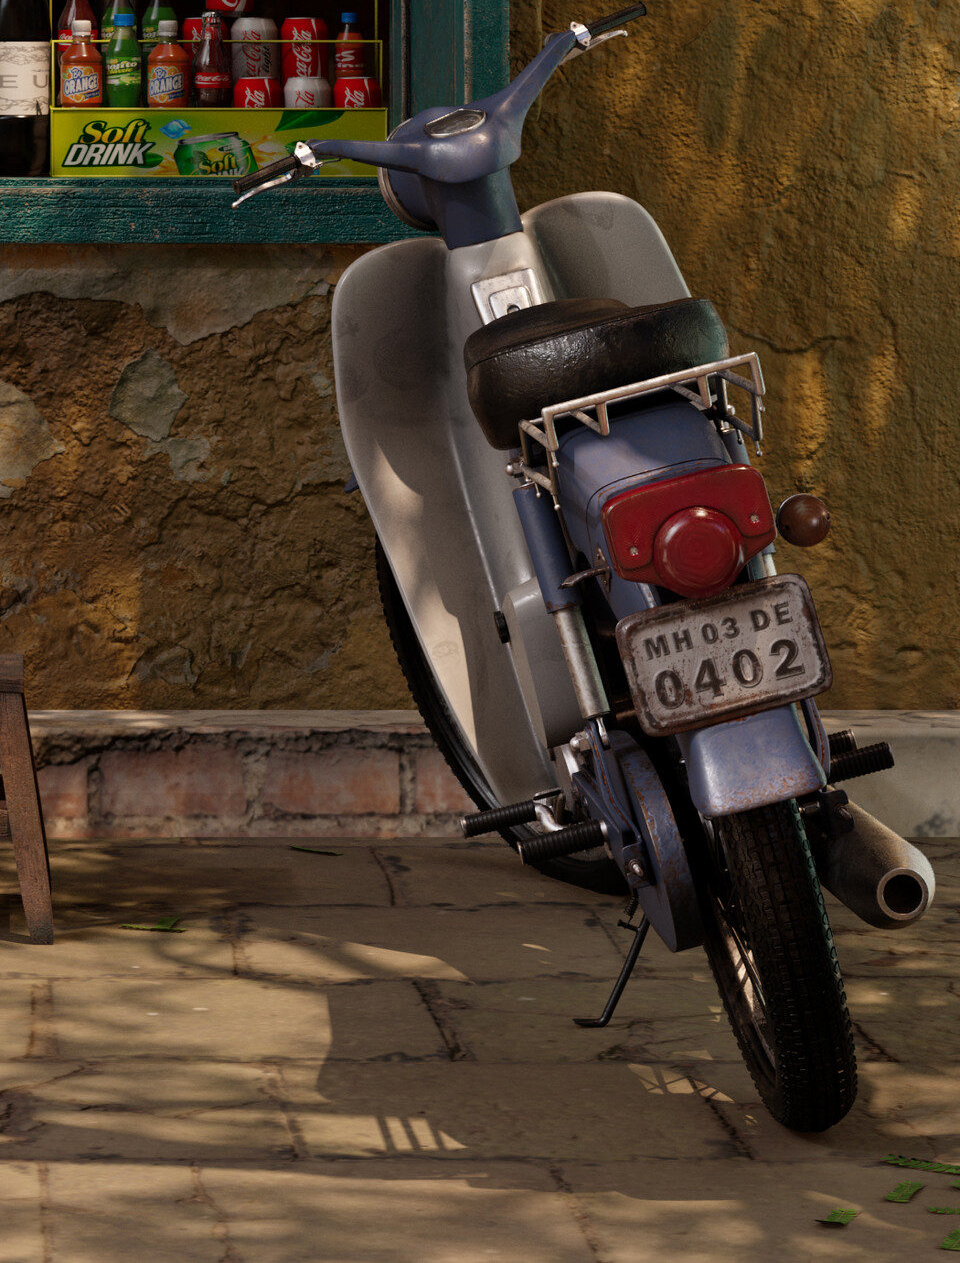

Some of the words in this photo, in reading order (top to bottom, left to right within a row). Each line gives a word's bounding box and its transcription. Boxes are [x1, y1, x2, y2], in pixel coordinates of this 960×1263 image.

[64, 73, 99, 96] ORANGE
[149, 73, 184, 96] ORANGE
[195, 74, 230, 82] Coca-Cola
[79, 119, 150, 144] Soft
[63, 142, 155, 167] DRINK
[199, 153, 236, 175] Soft
[643, 629, 694, 661] MH
[701, 617, 740, 645] 03
[749, 601, 794, 633] DE
[654, 639, 806, 710] 0402
